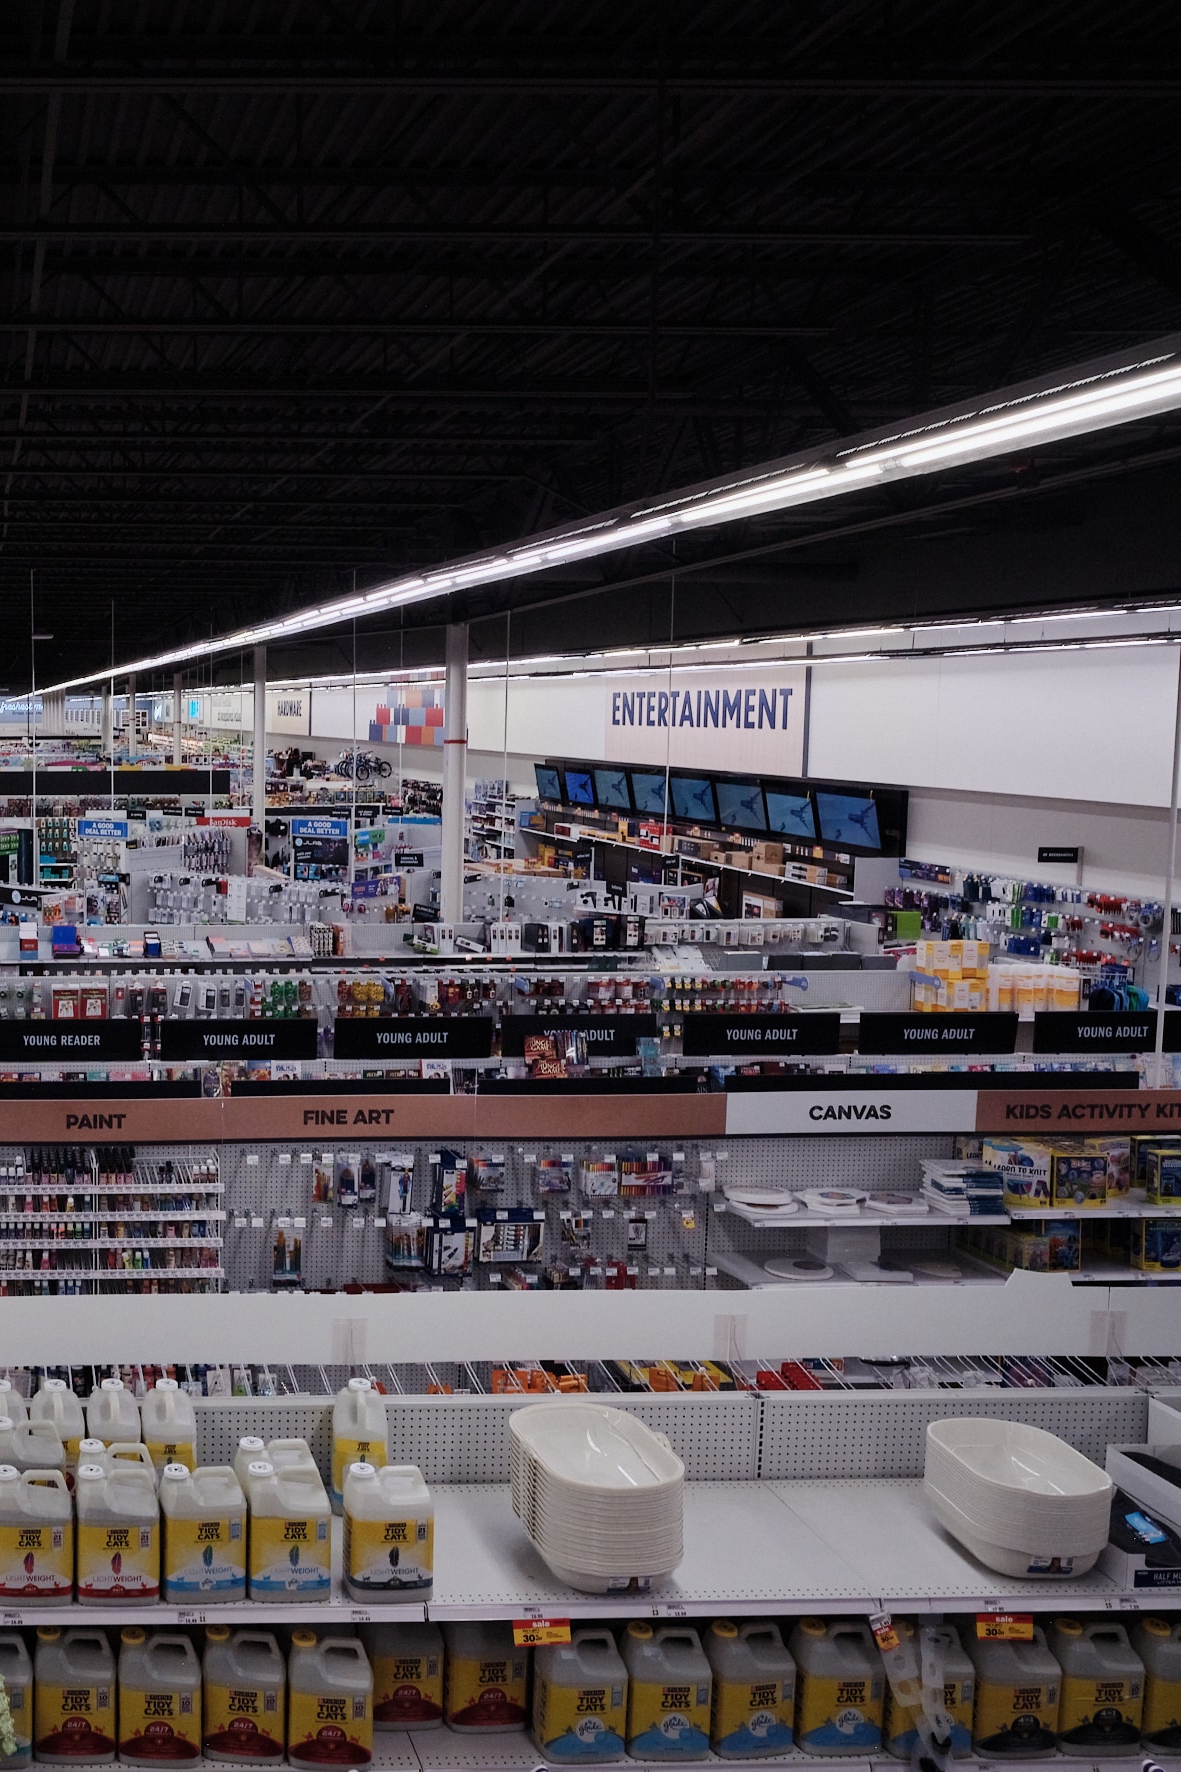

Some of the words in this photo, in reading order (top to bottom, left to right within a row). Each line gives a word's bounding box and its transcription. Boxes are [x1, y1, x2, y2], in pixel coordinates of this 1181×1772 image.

[277, 700, 302, 717] HARDWARE
[612, 688, 793, 730] ENTERTAINMENT
[209, 818, 237, 827] SanDisk
[85, 828, 101, 836] DEAL
[584, 1029, 615, 1041] ADULT
[726, 1029, 762, 1040] YOUNG
[765, 1028, 798, 1040] ADULT
[903, 1028, 939, 1040] YOUNG
[942, 1028, 975, 1040] ADULT
[1077, 1026, 1115, 1038] YOUNG
[1118, 1026, 1149, 1038] ADULT
[23, 1035, 57, 1046] YOUNG
[61, 1034, 101, 1046] READER
[203, 1034, 239, 1046] YOUNG
[241, 1034, 276, 1045] ADULT
[376, 1032, 412, 1044] YOUNG
[415, 1031, 449, 1043] ADULT
[809, 1105, 892, 1121] CANVAS
[1005, 1104, 1052, 1119] KIDS
[1057, 1103, 1151, 1119] ACTIVITY
[66, 1113, 126, 1130] PAINT
[303, 1109, 348, 1125] FINE
[352, 1109, 395, 1125] ART
[1029, 1169, 1048, 1177] KNIT
[198, 1527, 219, 1535] TIDY
[197, 1533, 220, 1541] CATS
[1153, 1572, 1170, 1581] HALF
[995, 1615, 1013, 1623] sale
[395, 1664, 419, 1672] TIDY
[481, 1668, 504, 1676] TIDY
[393, 1671, 421, 1680] CATS
[479, 1675, 507, 1683] CATS
[751, 1690, 776, 1700] TIDY
[838, 1687, 863, 1696] TIDY
[1096, 1689, 1122, 1697] TIDY
[62, 1696, 90, 1704] TIDY
[230, 1697, 256, 1705] TIDY
[579, 1696, 604, 1704] TIDY
[663, 1693, 689, 1701] TIDY
[837, 1694, 865, 1704] CATS
[1014, 1694, 1040, 1703] TIDY
[1095, 1695, 1123, 1703] CATS
[145, 1701, 172, 1709] TIDY
[661, 1700, 690, 1708] CATS
[749, 1697, 777, 1707] CATS
[1013, 1701, 1041, 1710] CATS
[61, 1703, 91, 1711] CATS
[229, 1704, 258, 1713] CATS
[318, 1704, 345, 1713] TIDY
[577, 1703, 605, 1712] CATS
[144, 1708, 173, 1716] CATS
[317, 1712, 346, 1720] CATS
[751, 1714, 775, 1732] glade
[838, 1711, 863, 1728] glade
[578, 1720, 603, 1738] glade
[663, 1716, 688, 1733] glade
[322, 1730, 341, 1738] 24/7
